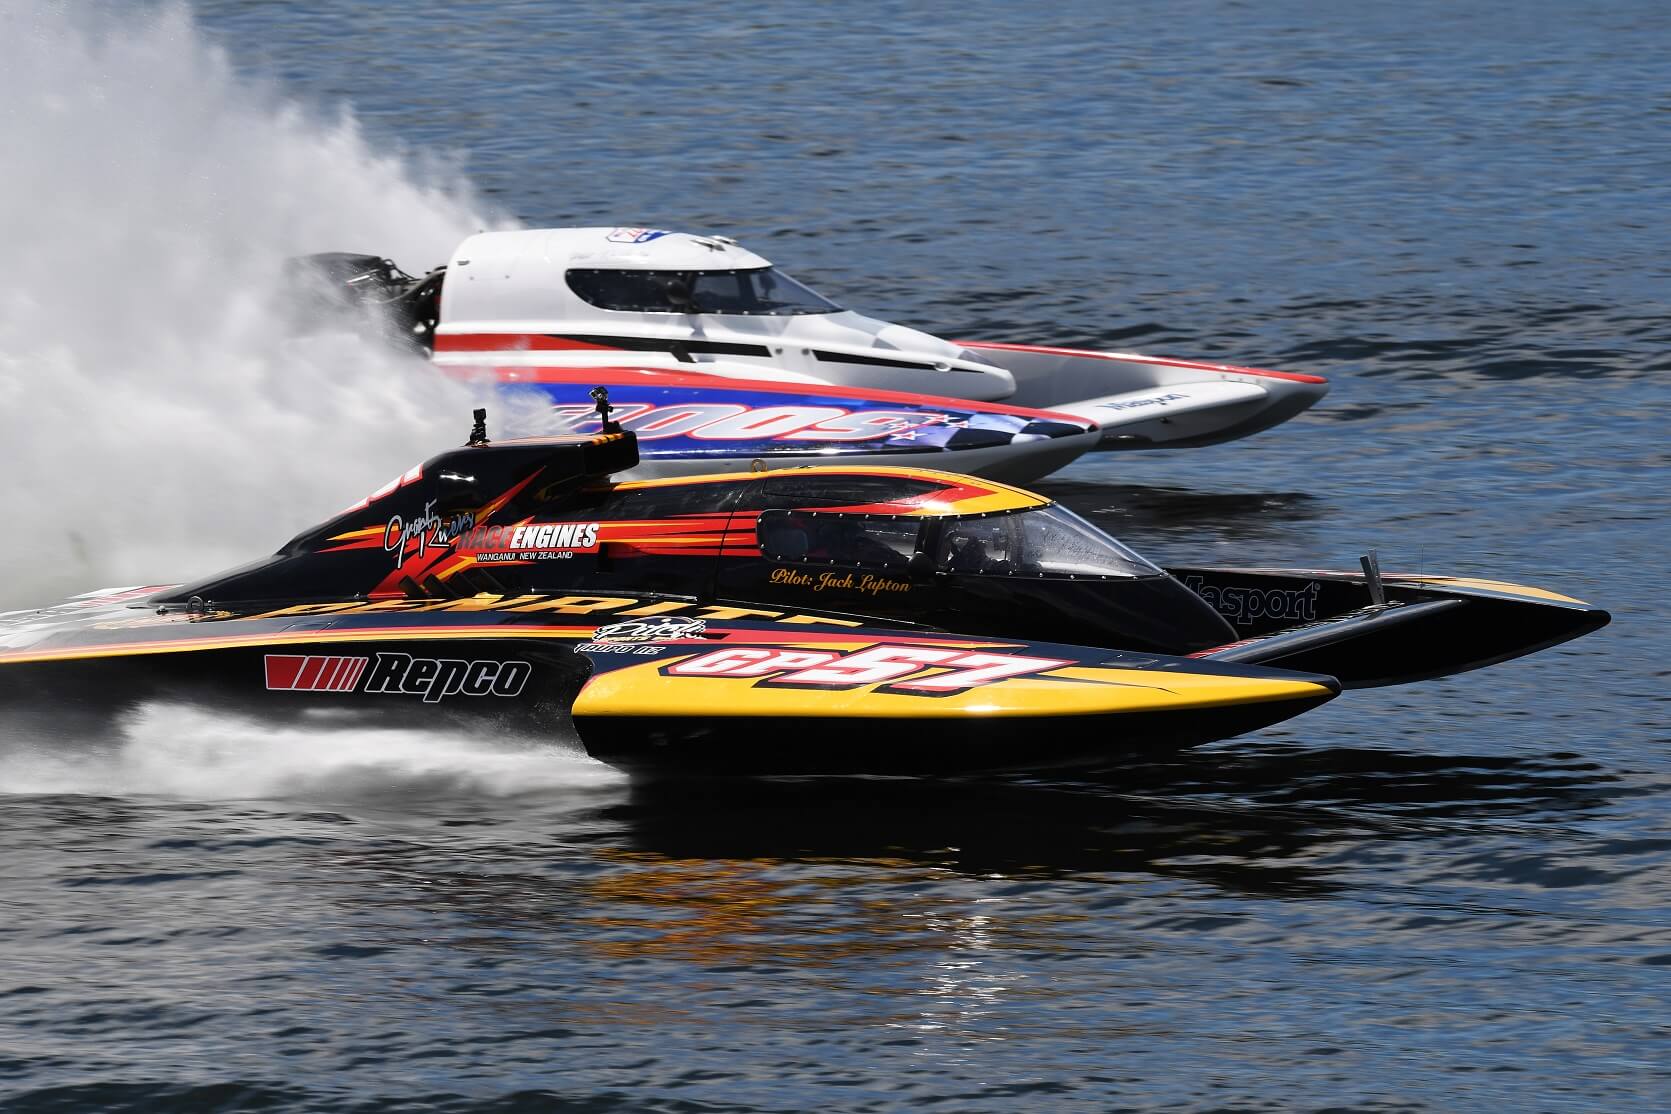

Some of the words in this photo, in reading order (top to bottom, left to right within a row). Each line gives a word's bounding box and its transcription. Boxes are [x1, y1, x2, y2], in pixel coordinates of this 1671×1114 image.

[456, 524, 514, 550] RACE
[510, 523, 601, 549] ENGINES
[476, 552, 516, 562] WANGANUI
[519, 552, 537, 561] NEW
[538, 551, 573, 560] ZEALAND
[769, 568, 812, 586] Pilot:
[814, 572, 854, 592] Jack
[855, 574, 913, 596] Lupton
[364, 652, 532, 703] Repco
[664, 645, 1079, 694] GP57
